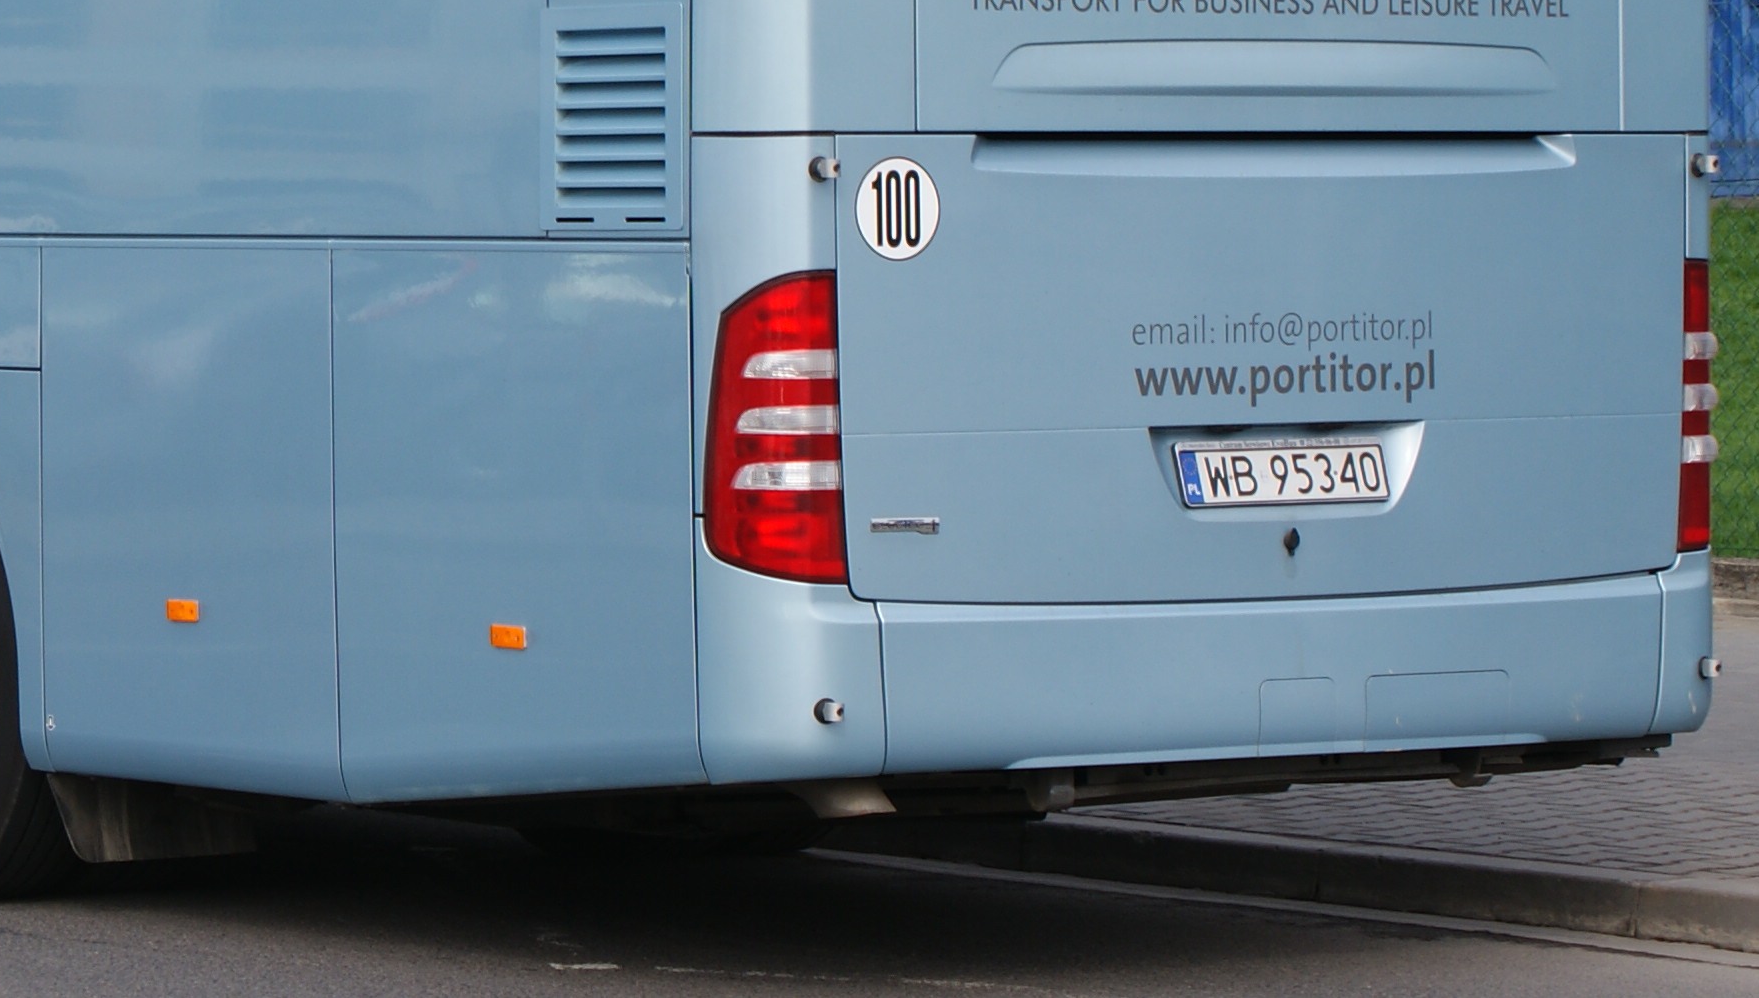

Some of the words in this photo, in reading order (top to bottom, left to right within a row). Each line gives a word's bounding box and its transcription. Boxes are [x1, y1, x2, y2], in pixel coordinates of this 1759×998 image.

[871, 169, 921, 248] 100
[1131, 313, 1215, 346] email:
[1225, 310, 1434, 351] info@portitor.pl
[1134, 349, 1436, 408] www.portitor.pl
[1187, 483, 1201, 496] PL
[1204, 455, 1258, 498] WB
[1269, 451, 1381, 495] 95340
